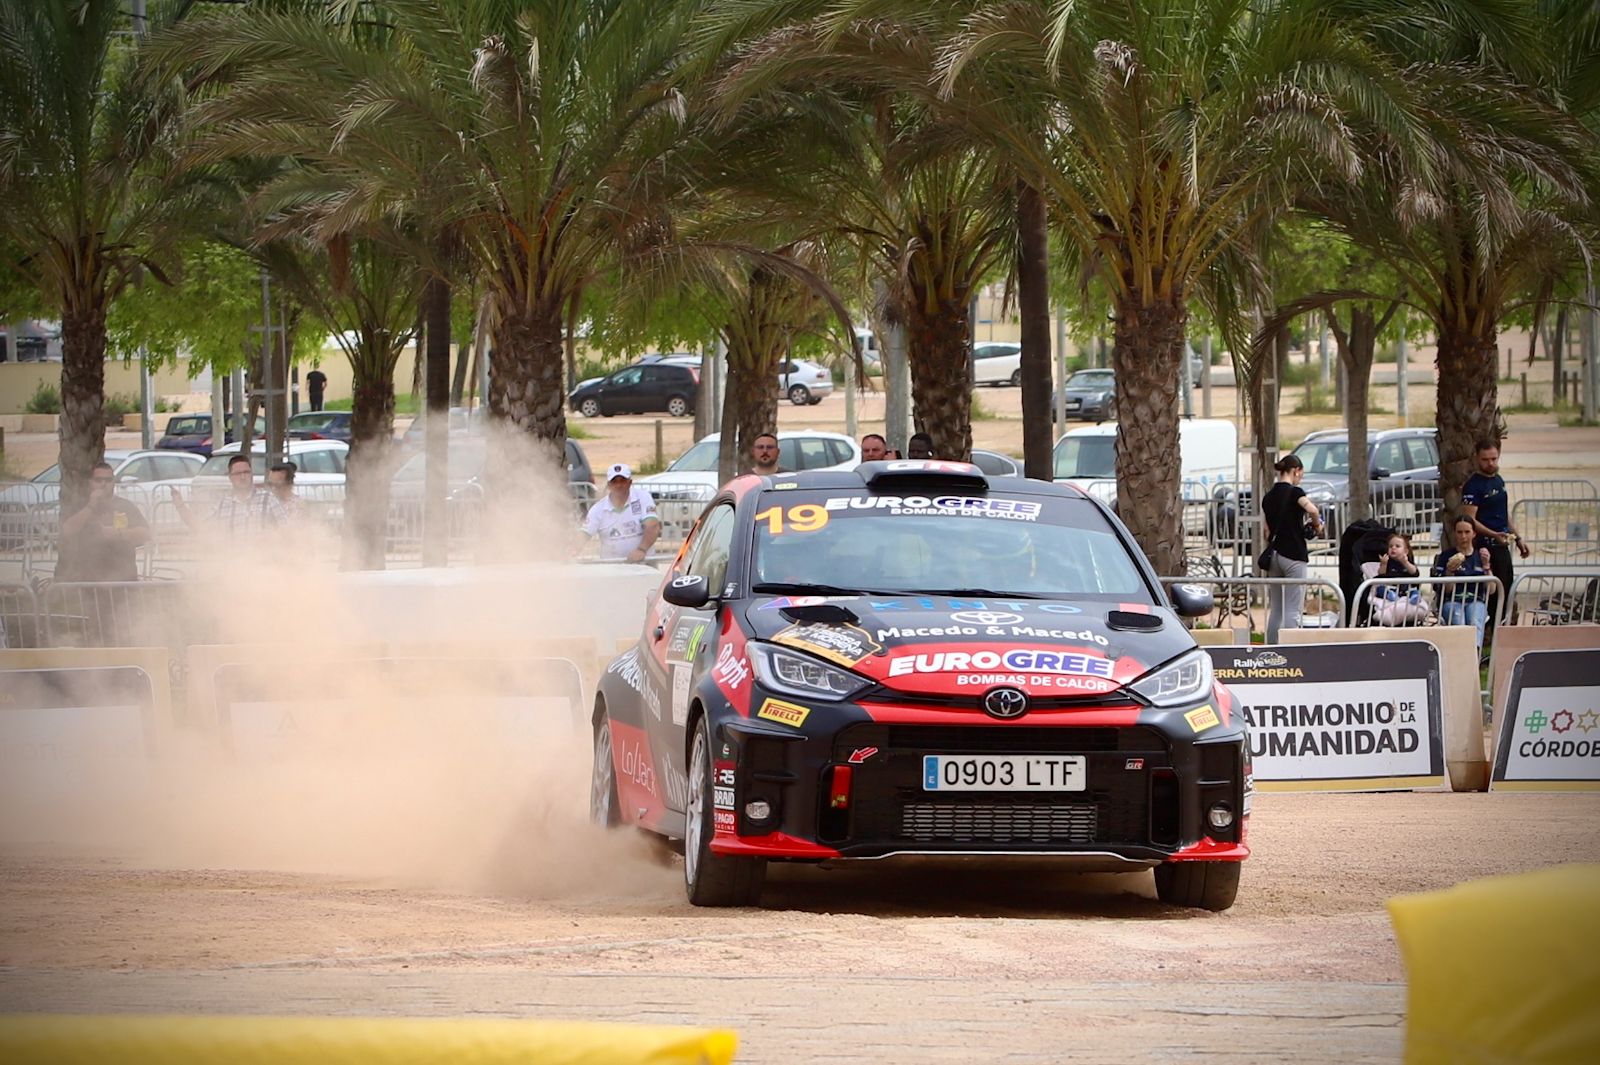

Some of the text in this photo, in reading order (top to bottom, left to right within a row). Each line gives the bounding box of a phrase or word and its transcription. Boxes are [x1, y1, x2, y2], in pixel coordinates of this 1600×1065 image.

[824, 496, 1041, 516] EUROGREE
[755, 505, 829, 534] 19
[890, 508, 1036, 522] BOMBAS DE CALOR
[869, 601, 1082, 614] KINTO
[878, 625, 1109, 646] Macedo & Macedo
[888, 650, 1112, 677] EUROGREE
[1233, 658, 1265, 670] Rallye
[1248, 667, 1304, 678] MORENA
[957, 675, 1108, 692] BOMBAS DE CALOR
[763, 702, 803, 722] PIRELLI
[1400, 702, 1416, 712] DE
[1400, 714, 1416, 723] LA
[944, 760, 1078, 786] 0903 LTF
[714, 790, 735, 806] BRAID
